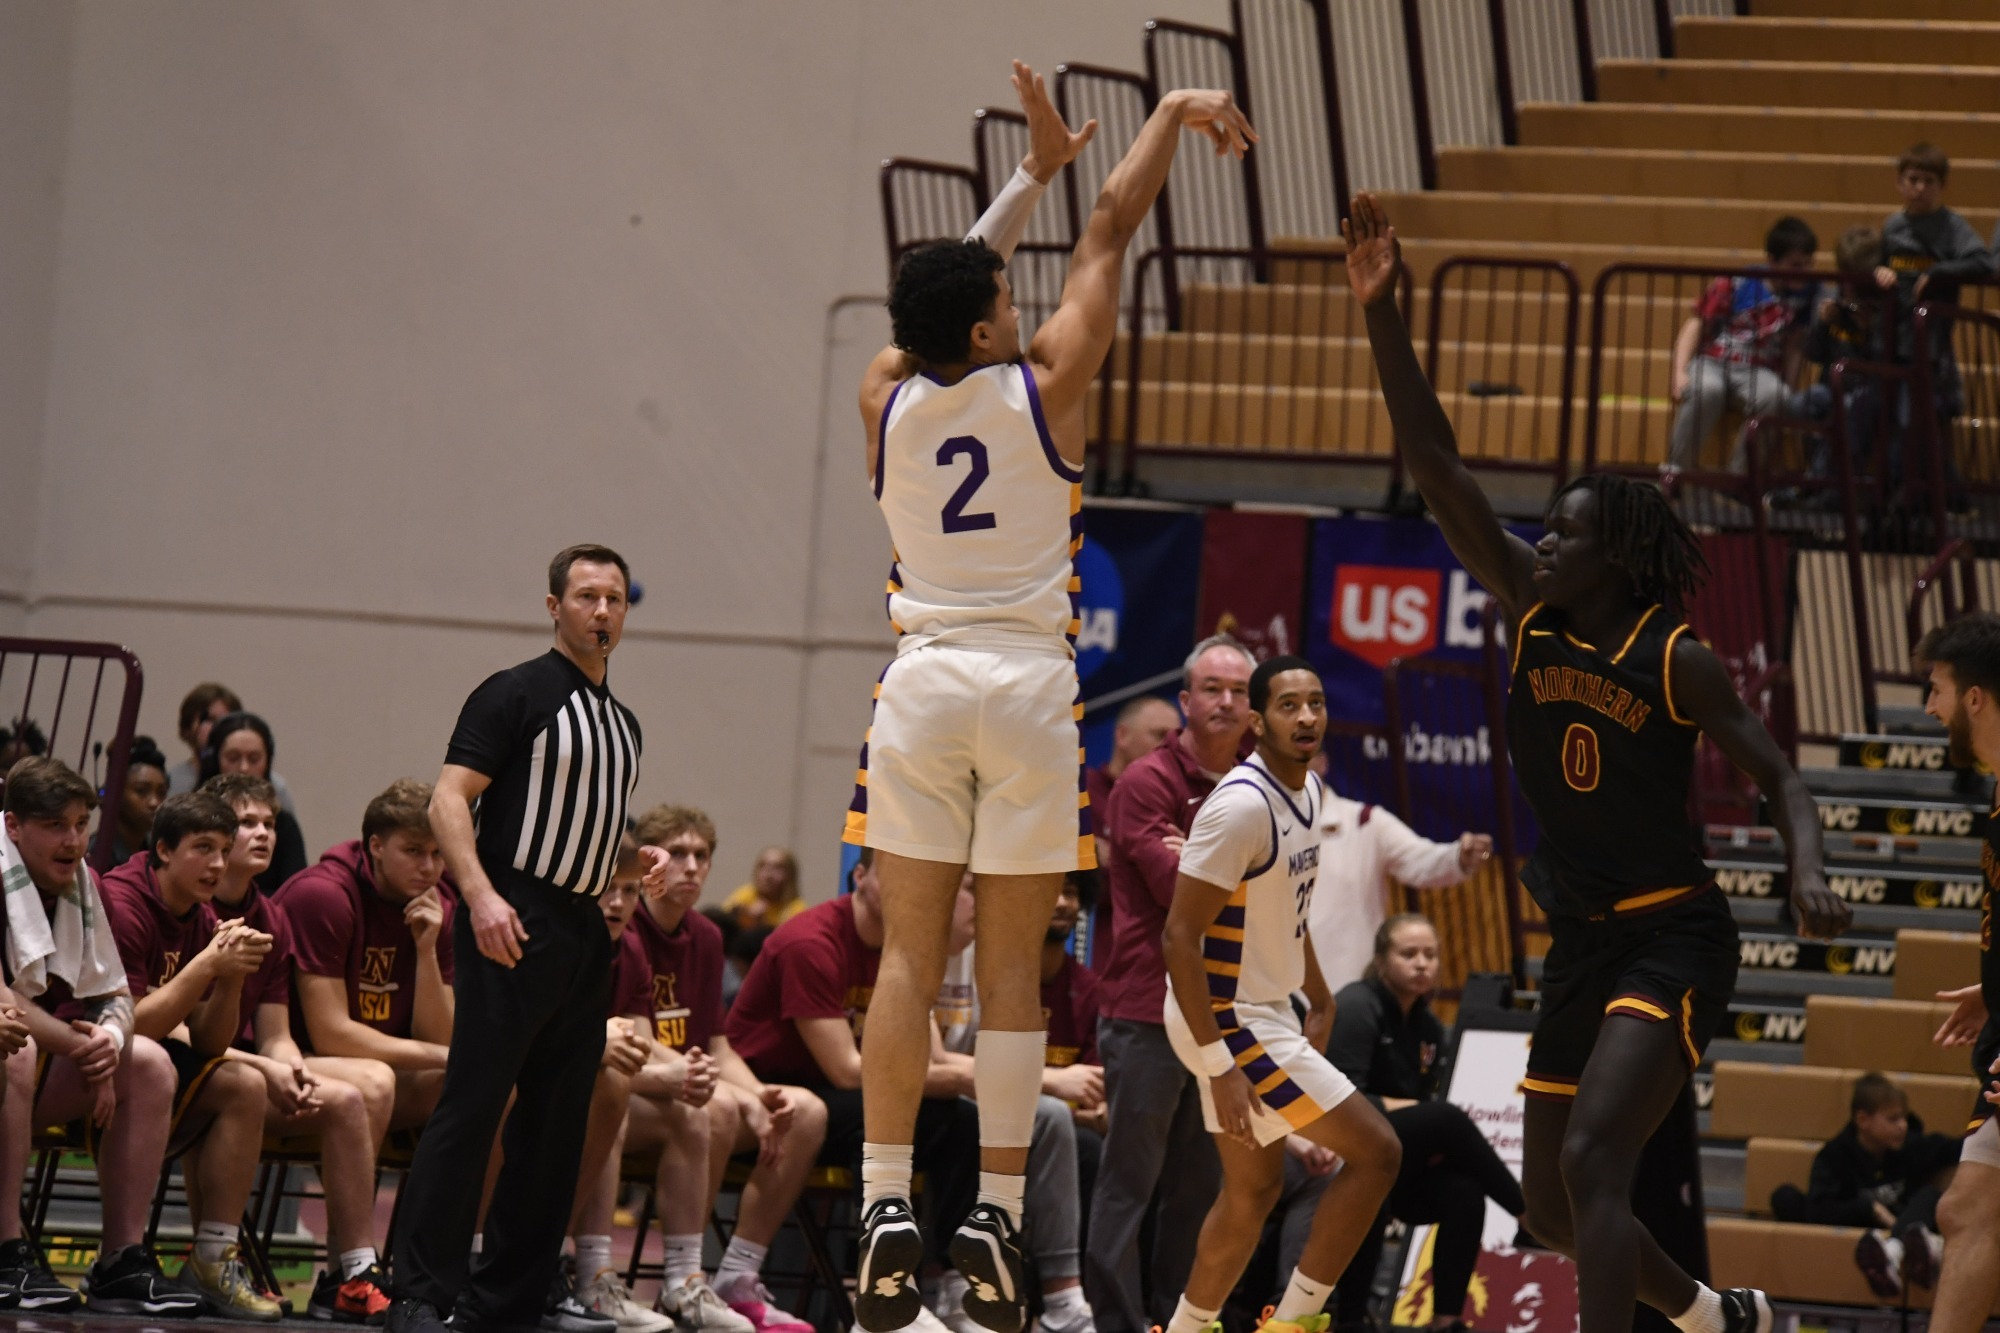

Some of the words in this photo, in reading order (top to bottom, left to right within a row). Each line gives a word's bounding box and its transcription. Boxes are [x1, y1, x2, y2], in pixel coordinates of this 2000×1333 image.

[936, 435, 997, 533] 2
[1340, 582, 1430, 645] us
[1528, 666, 1652, 733] NORTHERN
[1562, 723, 1600, 792] 0
[1886, 743, 1946, 770] NVC
[1914, 809, 1974, 836] NVC
[1715, 869, 1774, 897] NVC
[1828, 876, 1887, 902] NVC
[1941, 882, 1983, 908] NV
[361, 947, 396, 984] N
[1740, 940, 1799, 967] NVC
[1853, 948, 1896, 974] NV
[1763, 1014, 1806, 1040] NV
